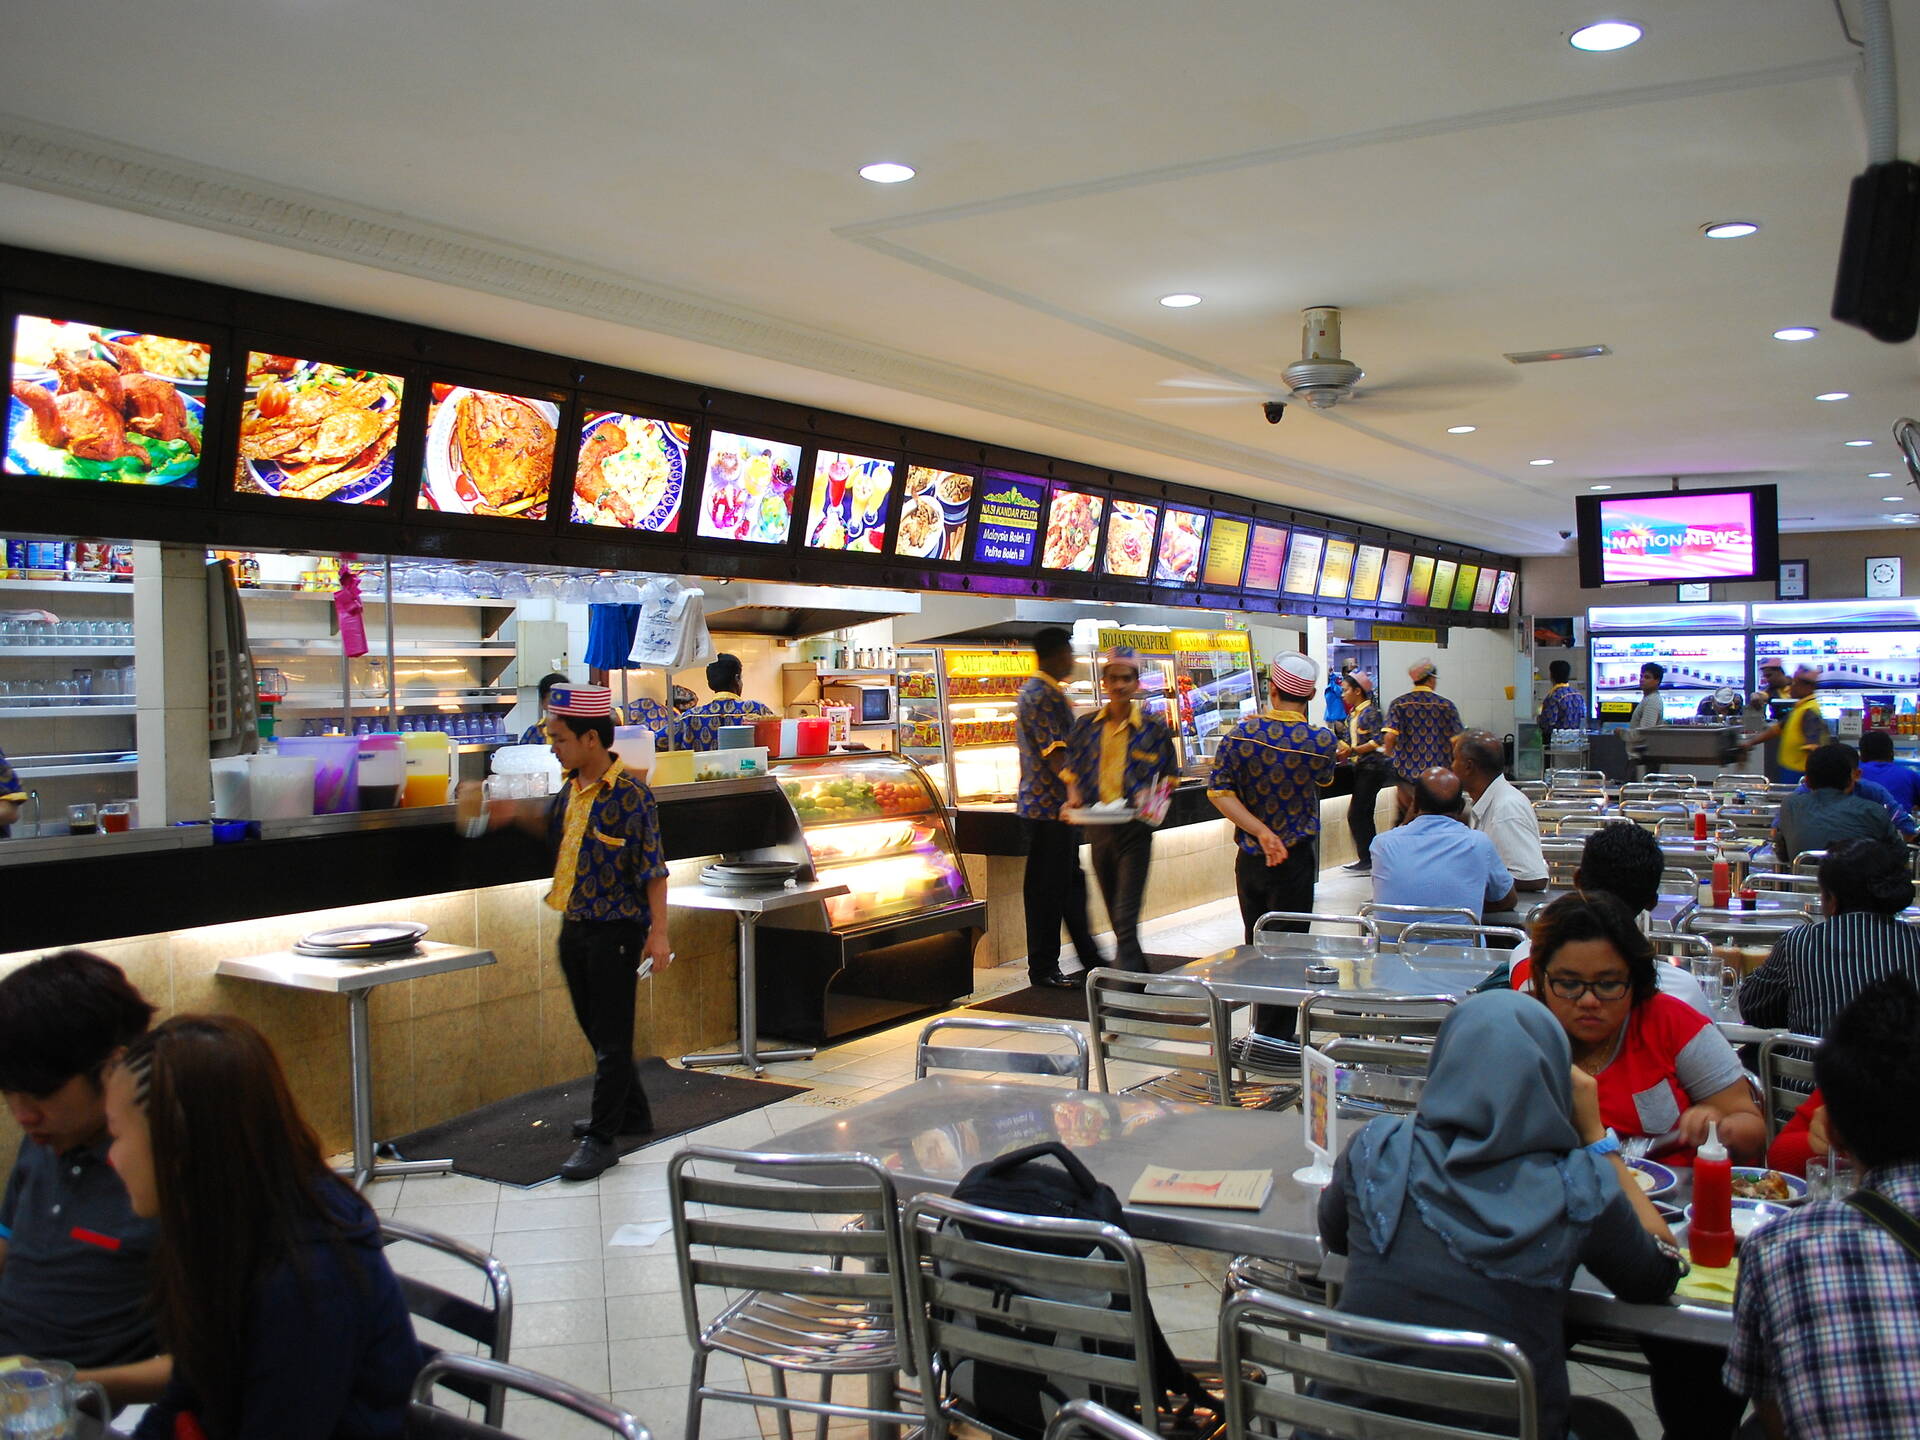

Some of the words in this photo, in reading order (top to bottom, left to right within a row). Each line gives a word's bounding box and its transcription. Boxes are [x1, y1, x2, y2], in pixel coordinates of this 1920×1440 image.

[982, 504, 996, 514] NASI
[996, 506, 1020, 517] KANDAR
[1020, 510, 1038, 520] PELITA
[983, 528, 1009, 543] Malaysia
[1010, 531, 1024, 543] Boleh
[1612, 534, 1682, 549] NATION
[1686, 531, 1742, 546] NEWS
[985, 545, 1002, 558] Pelita
[1002, 547, 1018, 559] Boleh
[1102, 632, 1128, 649] ROJAK
[1128, 634, 1169, 650] SINGAPURA
